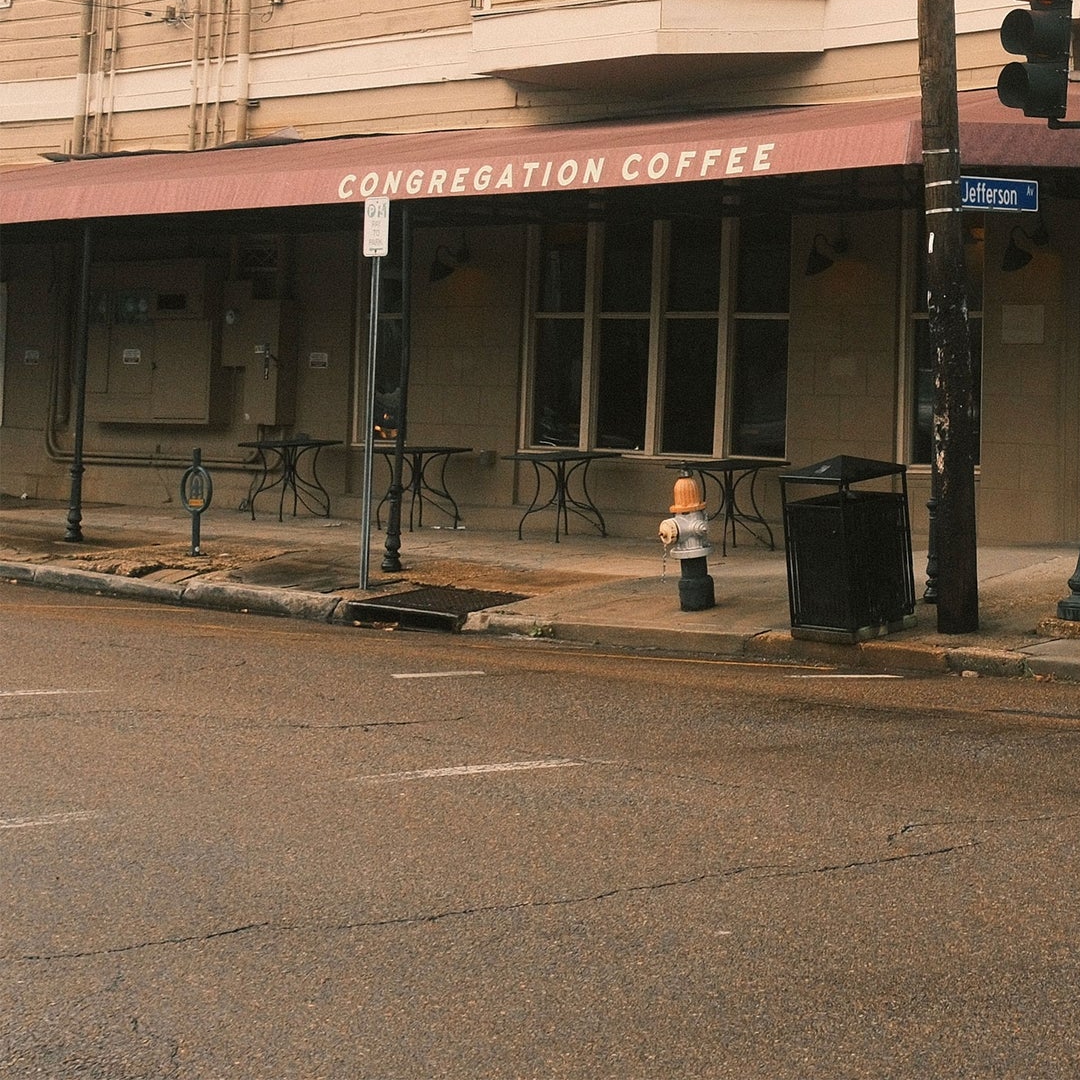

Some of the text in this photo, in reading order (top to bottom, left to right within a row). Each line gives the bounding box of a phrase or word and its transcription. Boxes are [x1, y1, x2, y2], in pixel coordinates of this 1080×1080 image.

[338, 143, 775, 199] CONGREGATION COFFEE
[962, 181, 1018, 206] Jefferson
